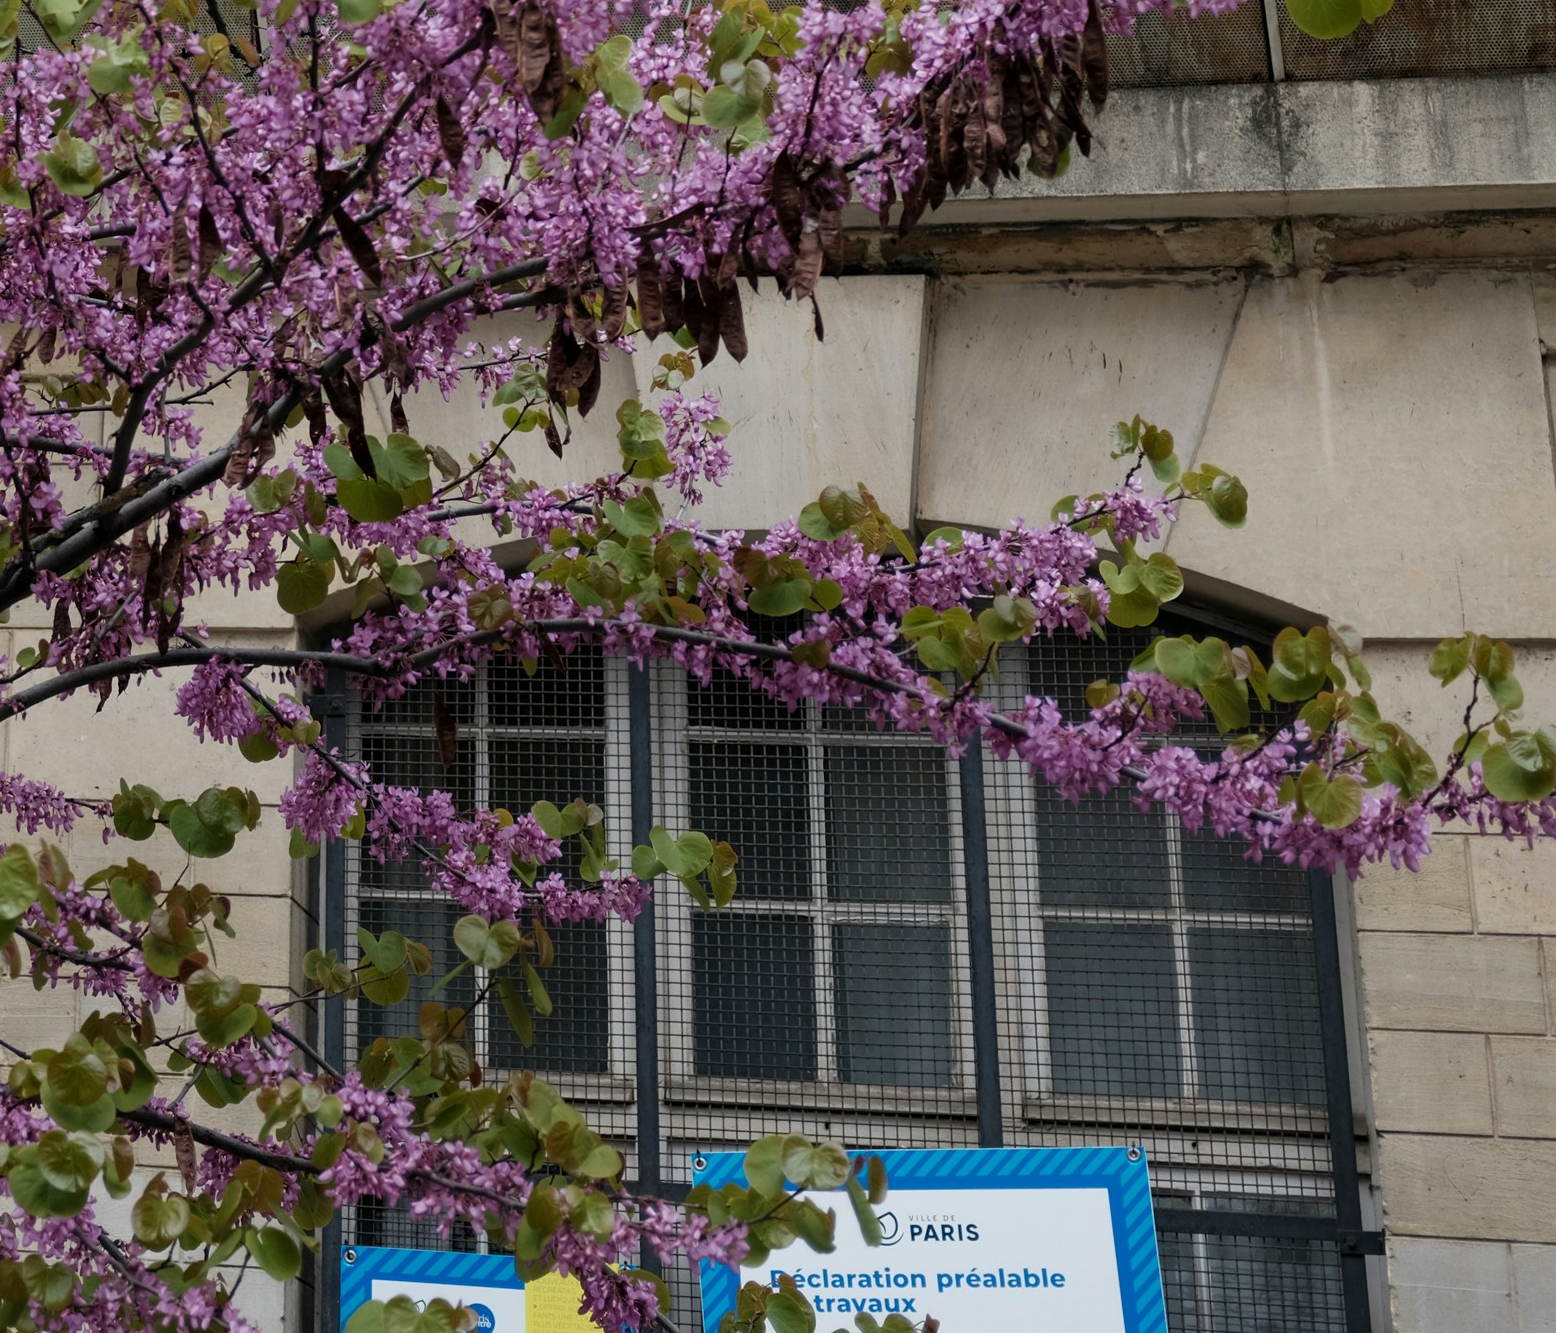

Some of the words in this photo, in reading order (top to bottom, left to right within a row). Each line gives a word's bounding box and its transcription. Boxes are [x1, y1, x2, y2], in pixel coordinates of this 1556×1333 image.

[909, 1224, 980, 1242] PARIS
[770, 1267, 927, 1289] Déclaration
[936, 1268, 1066, 1293] préalable
[813, 1294, 918, 1313] travaux
